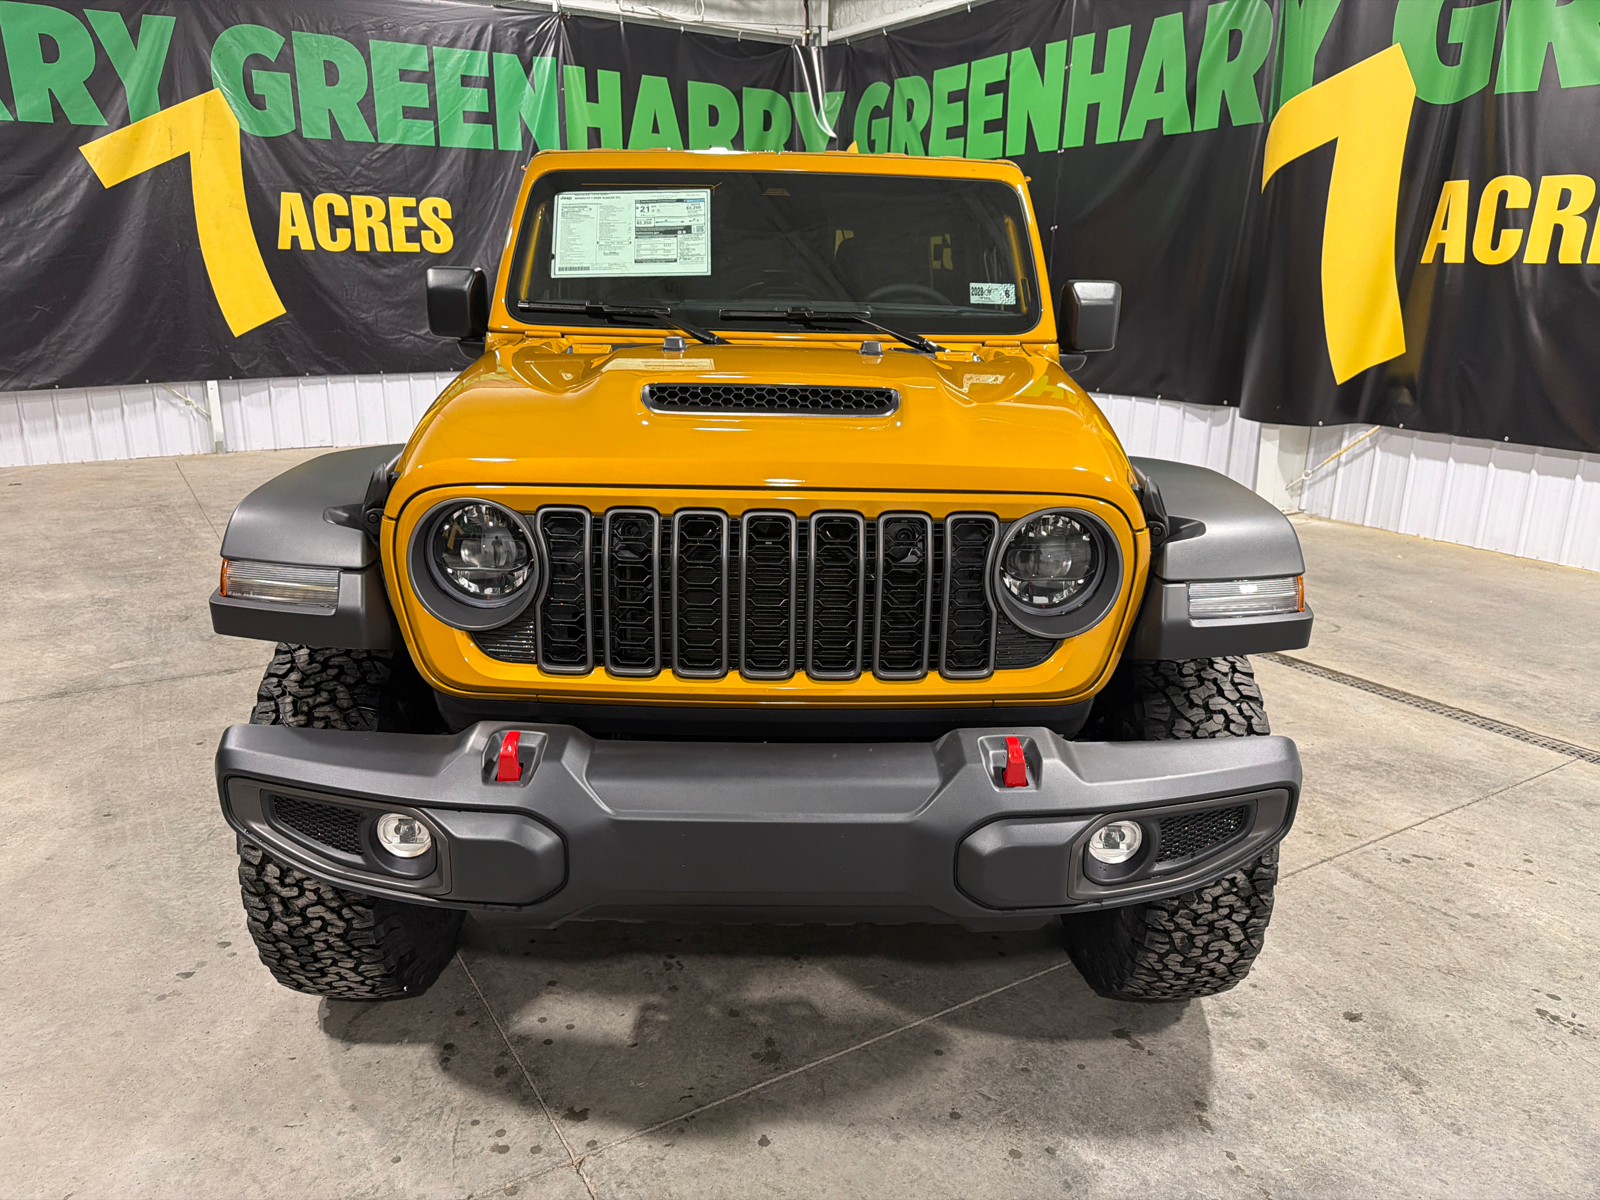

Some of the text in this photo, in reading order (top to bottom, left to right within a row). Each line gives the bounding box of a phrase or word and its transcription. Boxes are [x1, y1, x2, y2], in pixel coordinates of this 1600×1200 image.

[0, 0, 560, 151] RY GREEN
[563, 40, 1068, 159] HARRY GREEN
[1063, 0, 1341, 148] HARY
[78, 87, 454, 337] 7 ACRES
[640, 205, 650, 213] 21
[1261, 42, 1600, 386] 7 ACR
